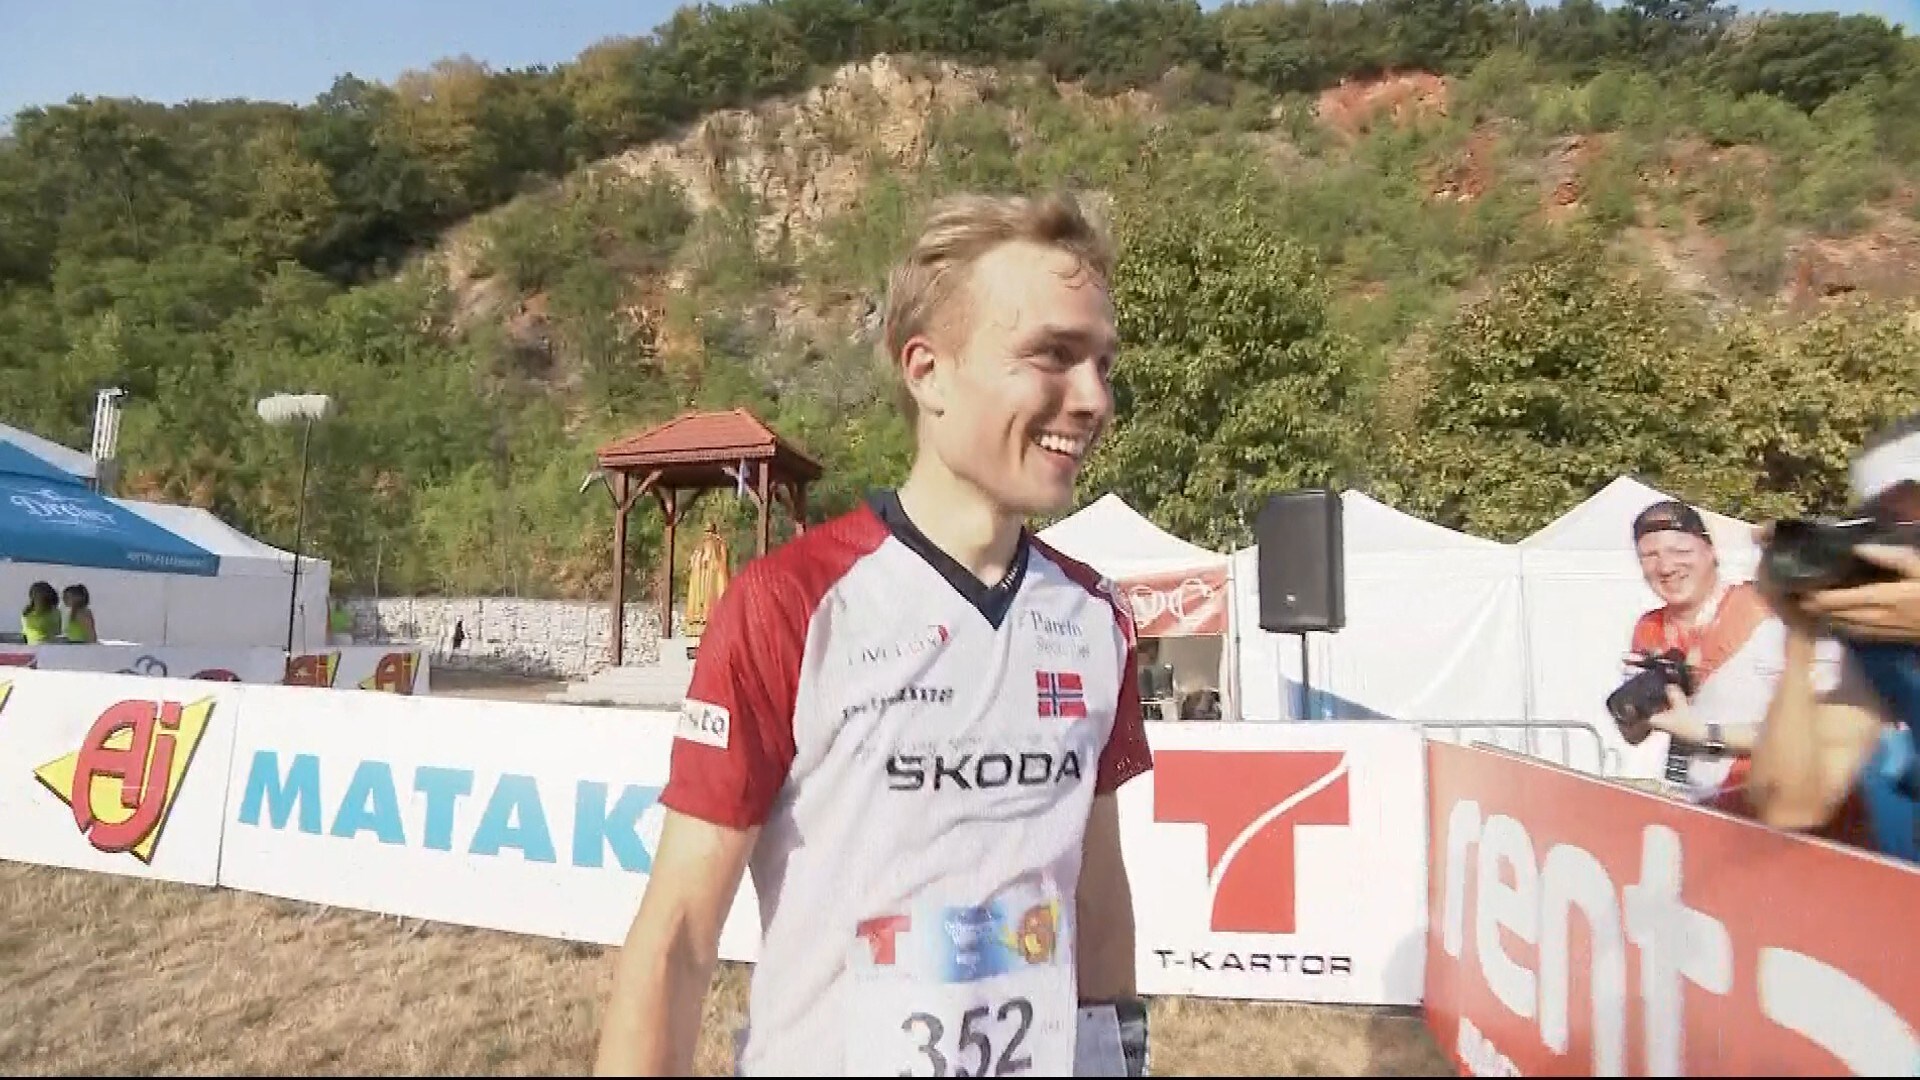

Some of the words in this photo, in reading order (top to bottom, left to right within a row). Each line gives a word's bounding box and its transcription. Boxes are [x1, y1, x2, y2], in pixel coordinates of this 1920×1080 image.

[1153, 949, 1353, 976] T-KARTOR
[1443, 799, 1734, 1077] rent
[899, 996, 1034, 1077] 352
